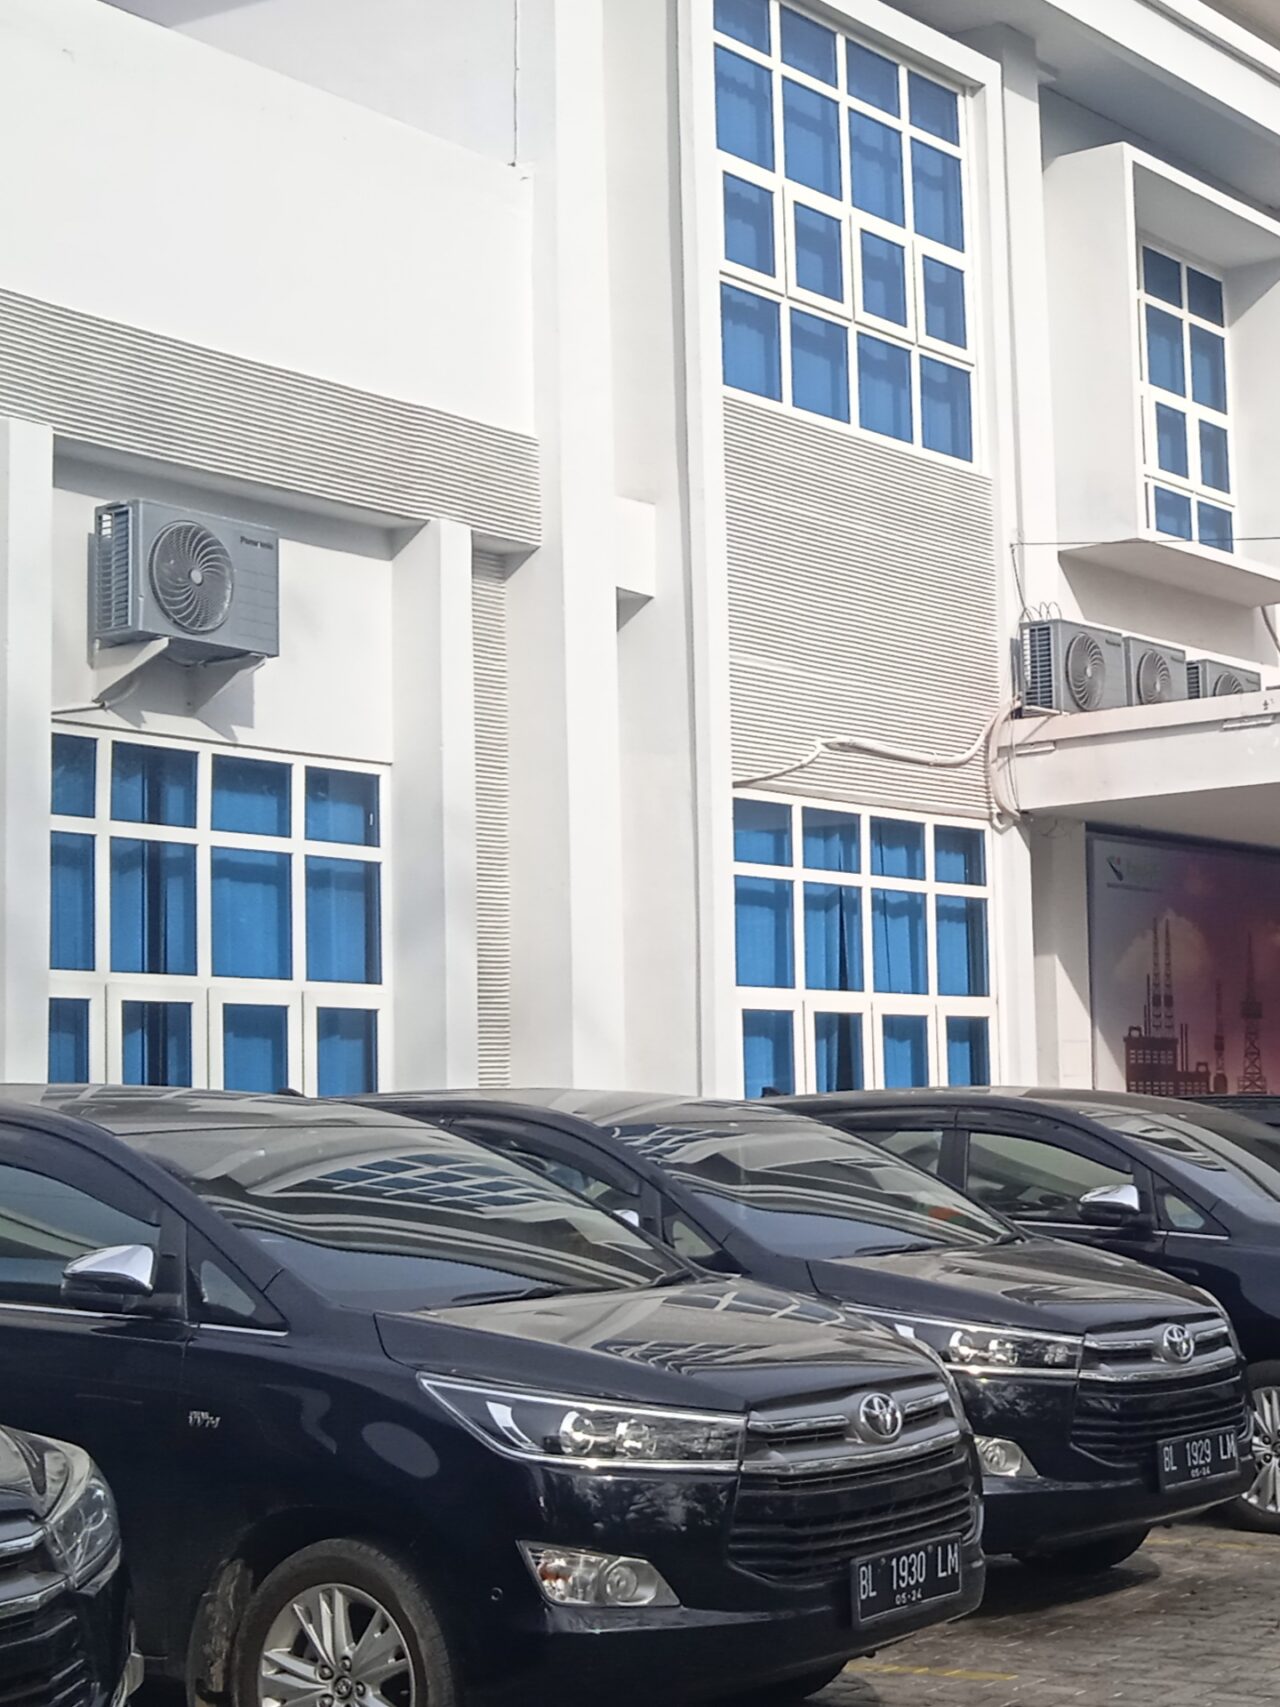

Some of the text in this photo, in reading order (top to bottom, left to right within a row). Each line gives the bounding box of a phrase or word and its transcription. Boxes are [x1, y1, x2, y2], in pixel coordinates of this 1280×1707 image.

[1163, 1433, 1237, 1472] BL 1929 LM
[859, 1542, 959, 1600] BL 1930 LM
